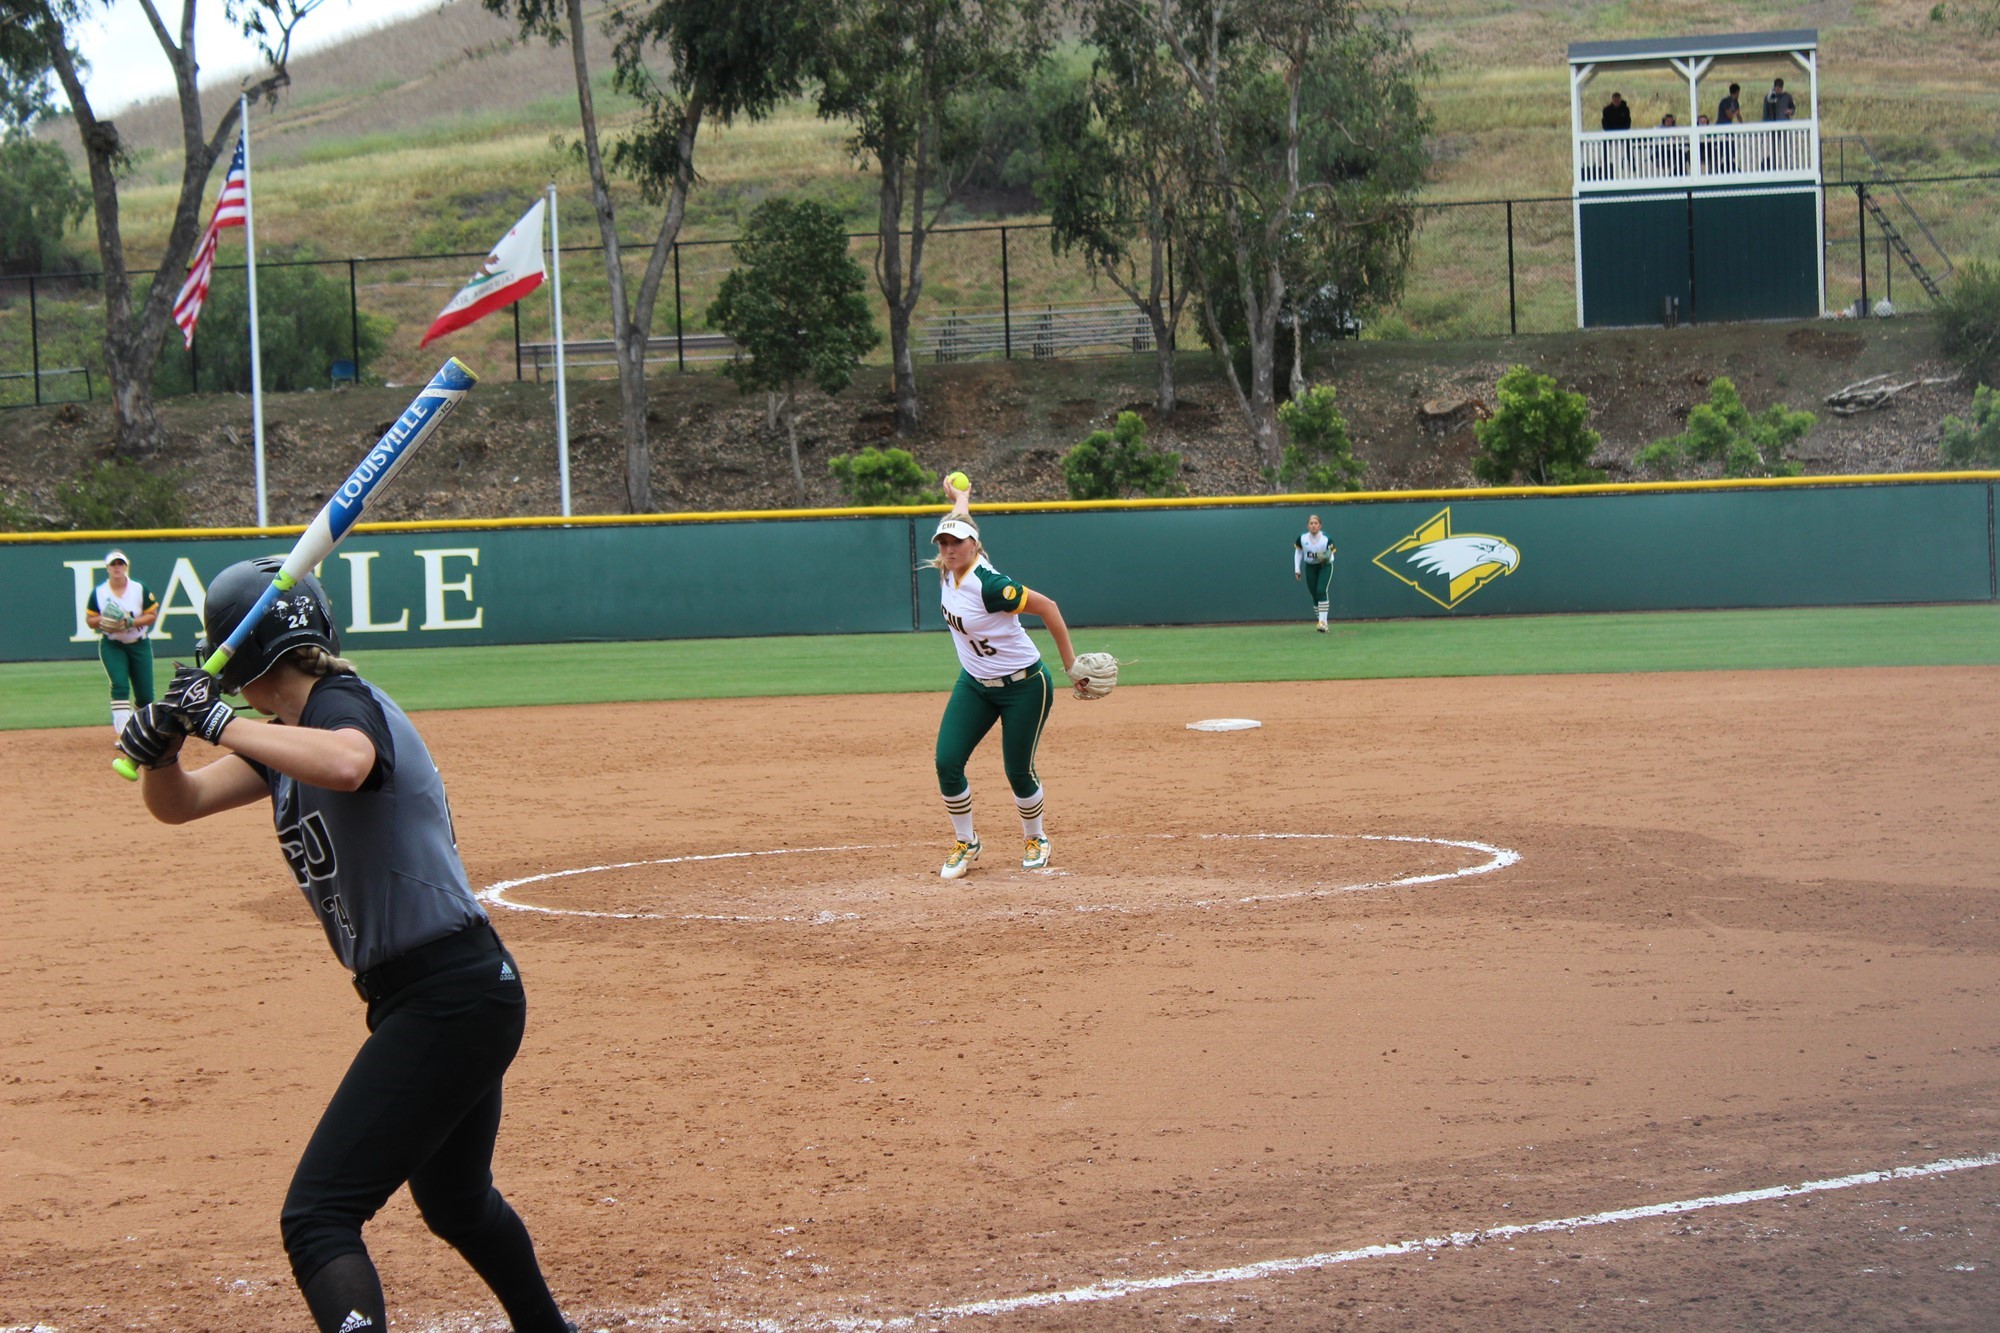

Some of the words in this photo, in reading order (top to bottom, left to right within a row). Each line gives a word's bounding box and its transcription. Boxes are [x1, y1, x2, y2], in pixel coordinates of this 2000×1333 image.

[335, 401, 428, 510] LOUISVILLE
[63, 547, 483, 643] EALE
[288, 613, 309, 629] 24
[969, 638, 998, 658] 15
[204, 705, 227, 739] LOUISVILLE
[338, 1315, 373, 1333] adidas
